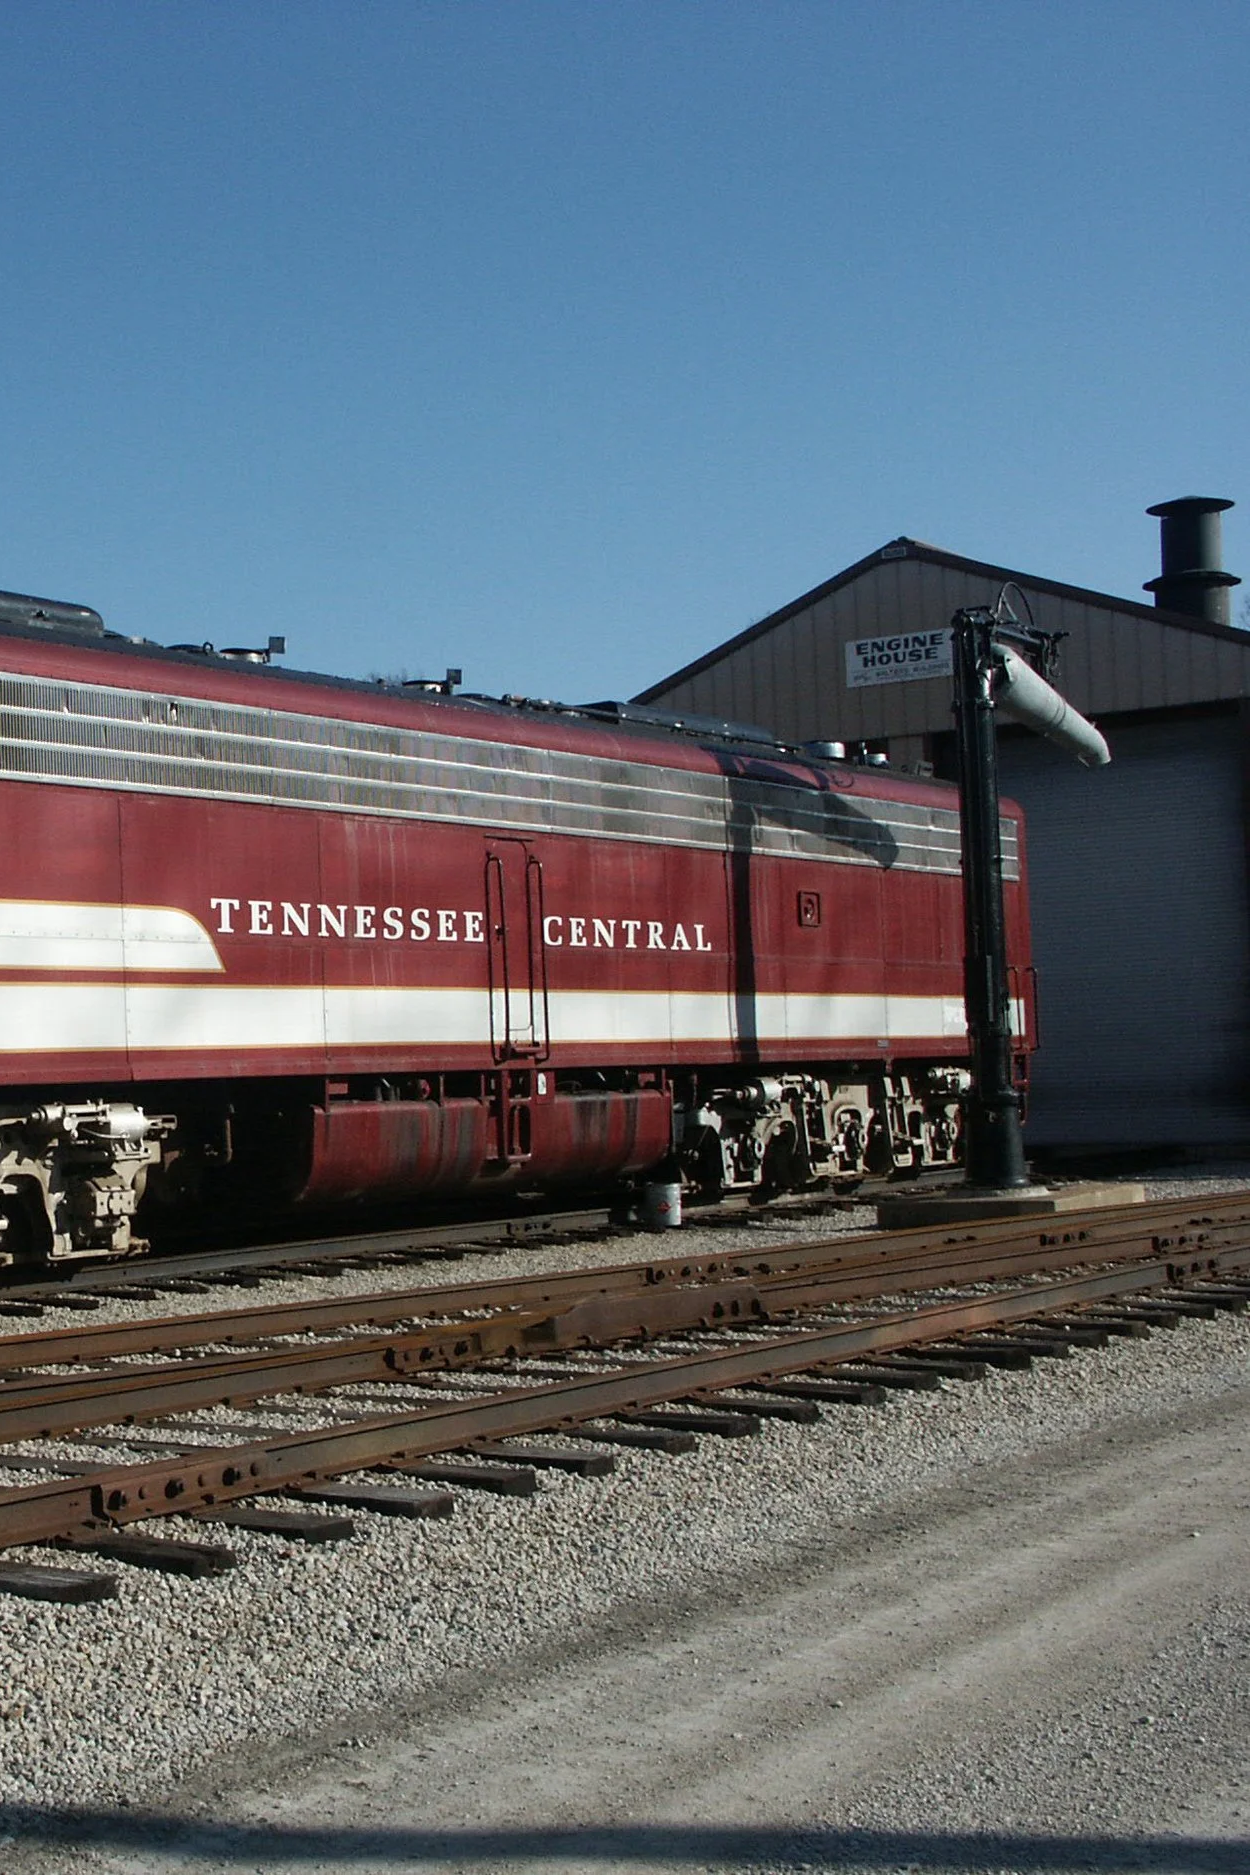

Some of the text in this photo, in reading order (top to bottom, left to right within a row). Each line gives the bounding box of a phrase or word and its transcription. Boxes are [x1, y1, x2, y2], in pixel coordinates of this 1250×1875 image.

[855, 632, 944, 656] ENGINE
[862, 646, 939, 668] HOUSE
[210, 897, 712, 951] TENNESSEE CENTRAL
